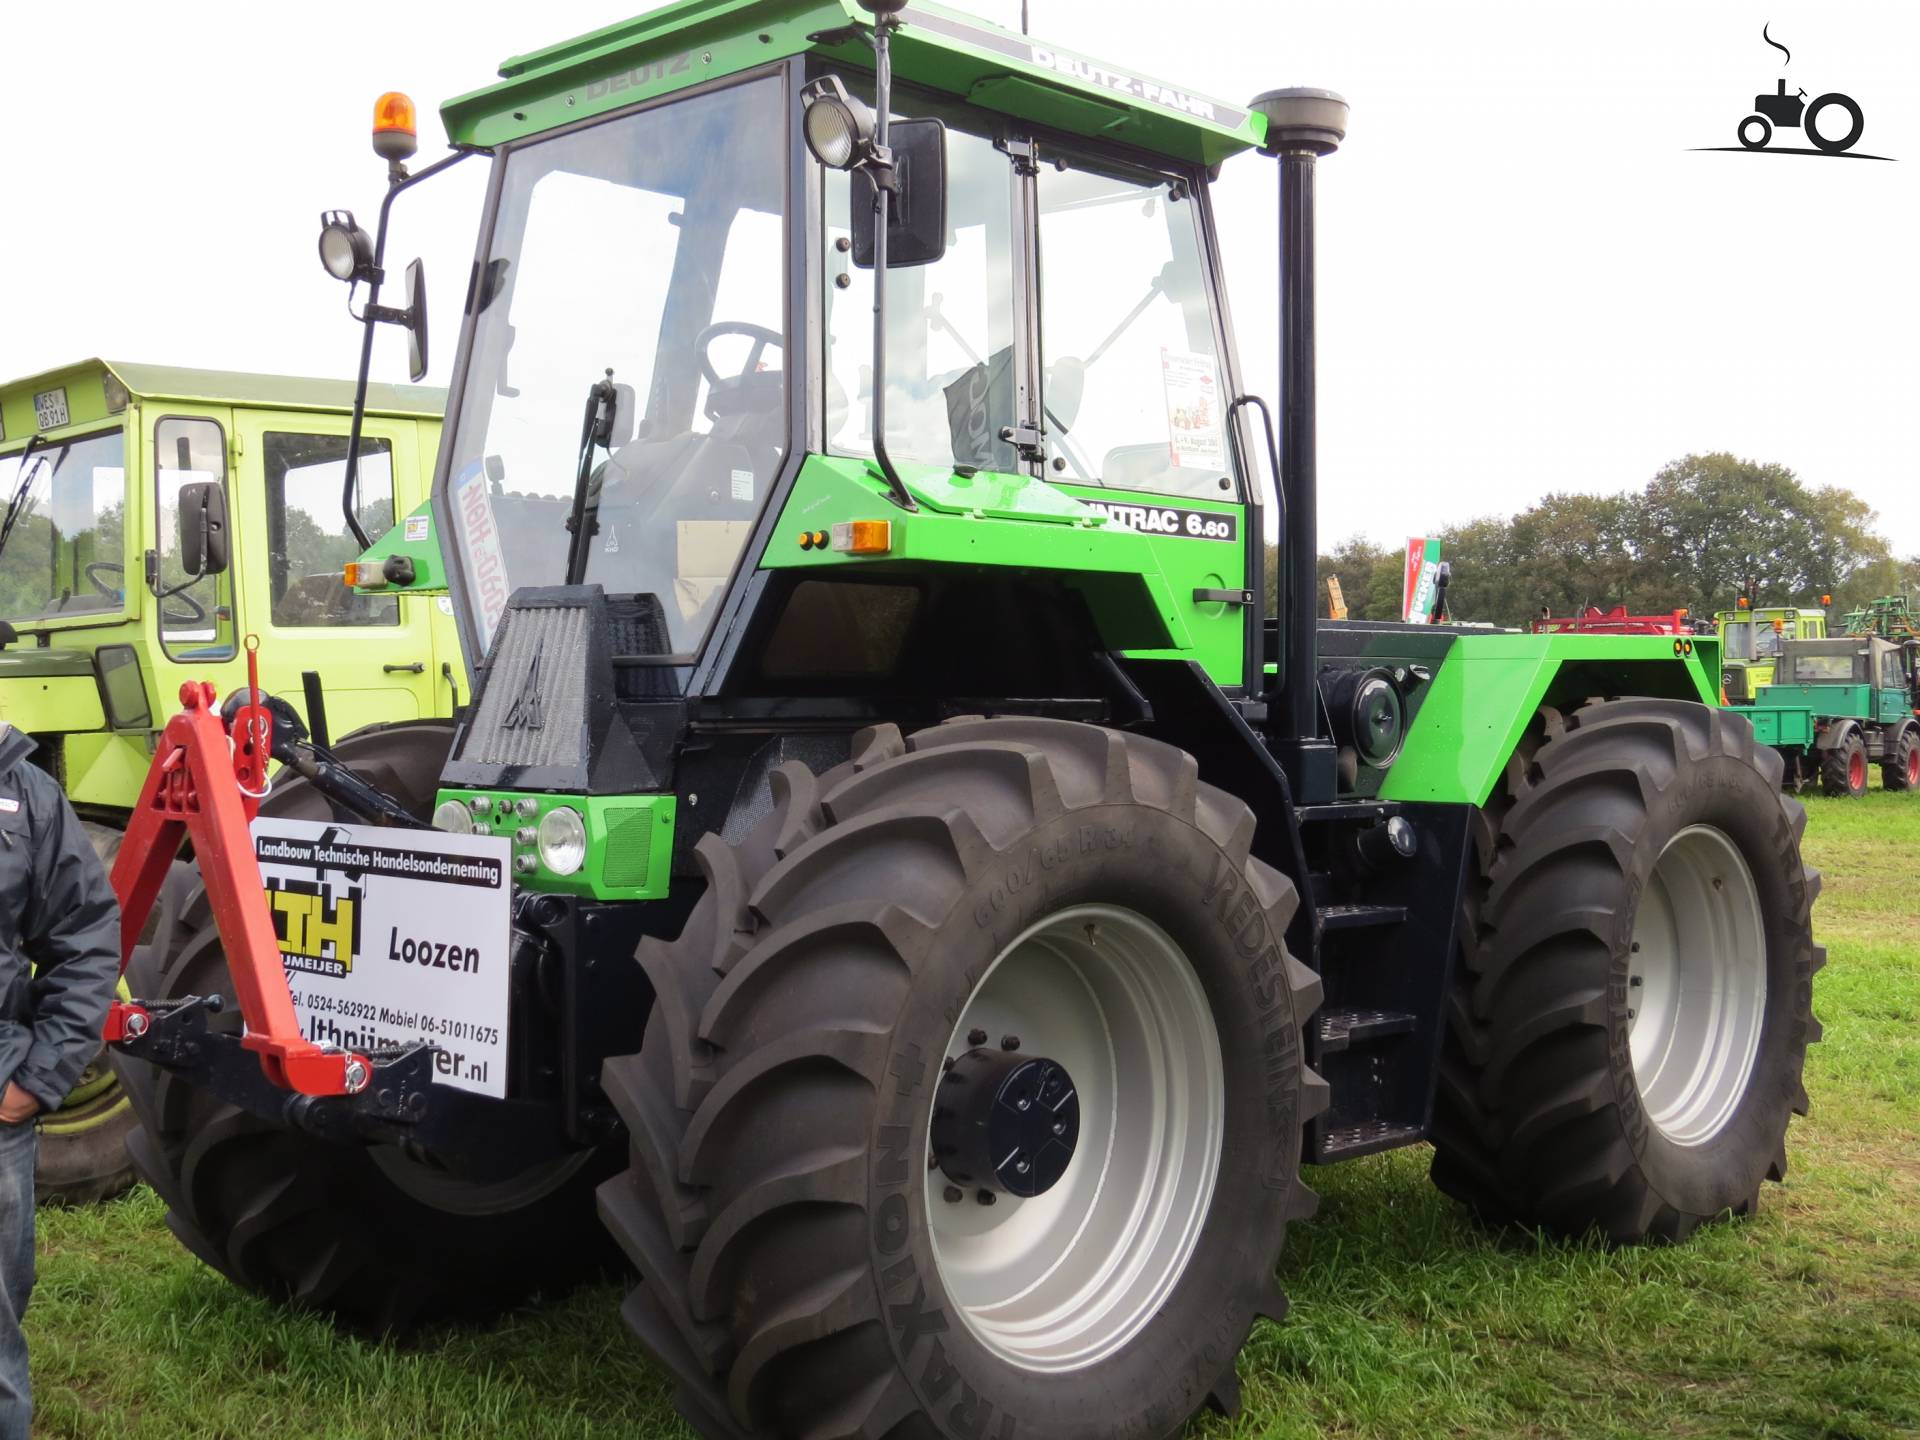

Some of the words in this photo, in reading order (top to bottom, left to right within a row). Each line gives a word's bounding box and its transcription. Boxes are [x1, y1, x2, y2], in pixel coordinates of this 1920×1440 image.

[586, 50, 691, 102] DEUTZ
[1031, 45, 1216, 121] DEUTZ-FAHR
[1186, 513, 1229, 538] 6.60
[259, 839, 311, 860] Landbouw
[313, 845, 370, 867] Technische
[373, 850, 498, 885] Handelsonderneming
[388, 926, 480, 974] Loozen
[307, 993, 376, 1021] 0524-562922
[379, 1009, 418, 1030] Mobiel
[420, 1015, 498, 1046] 06-51011675
